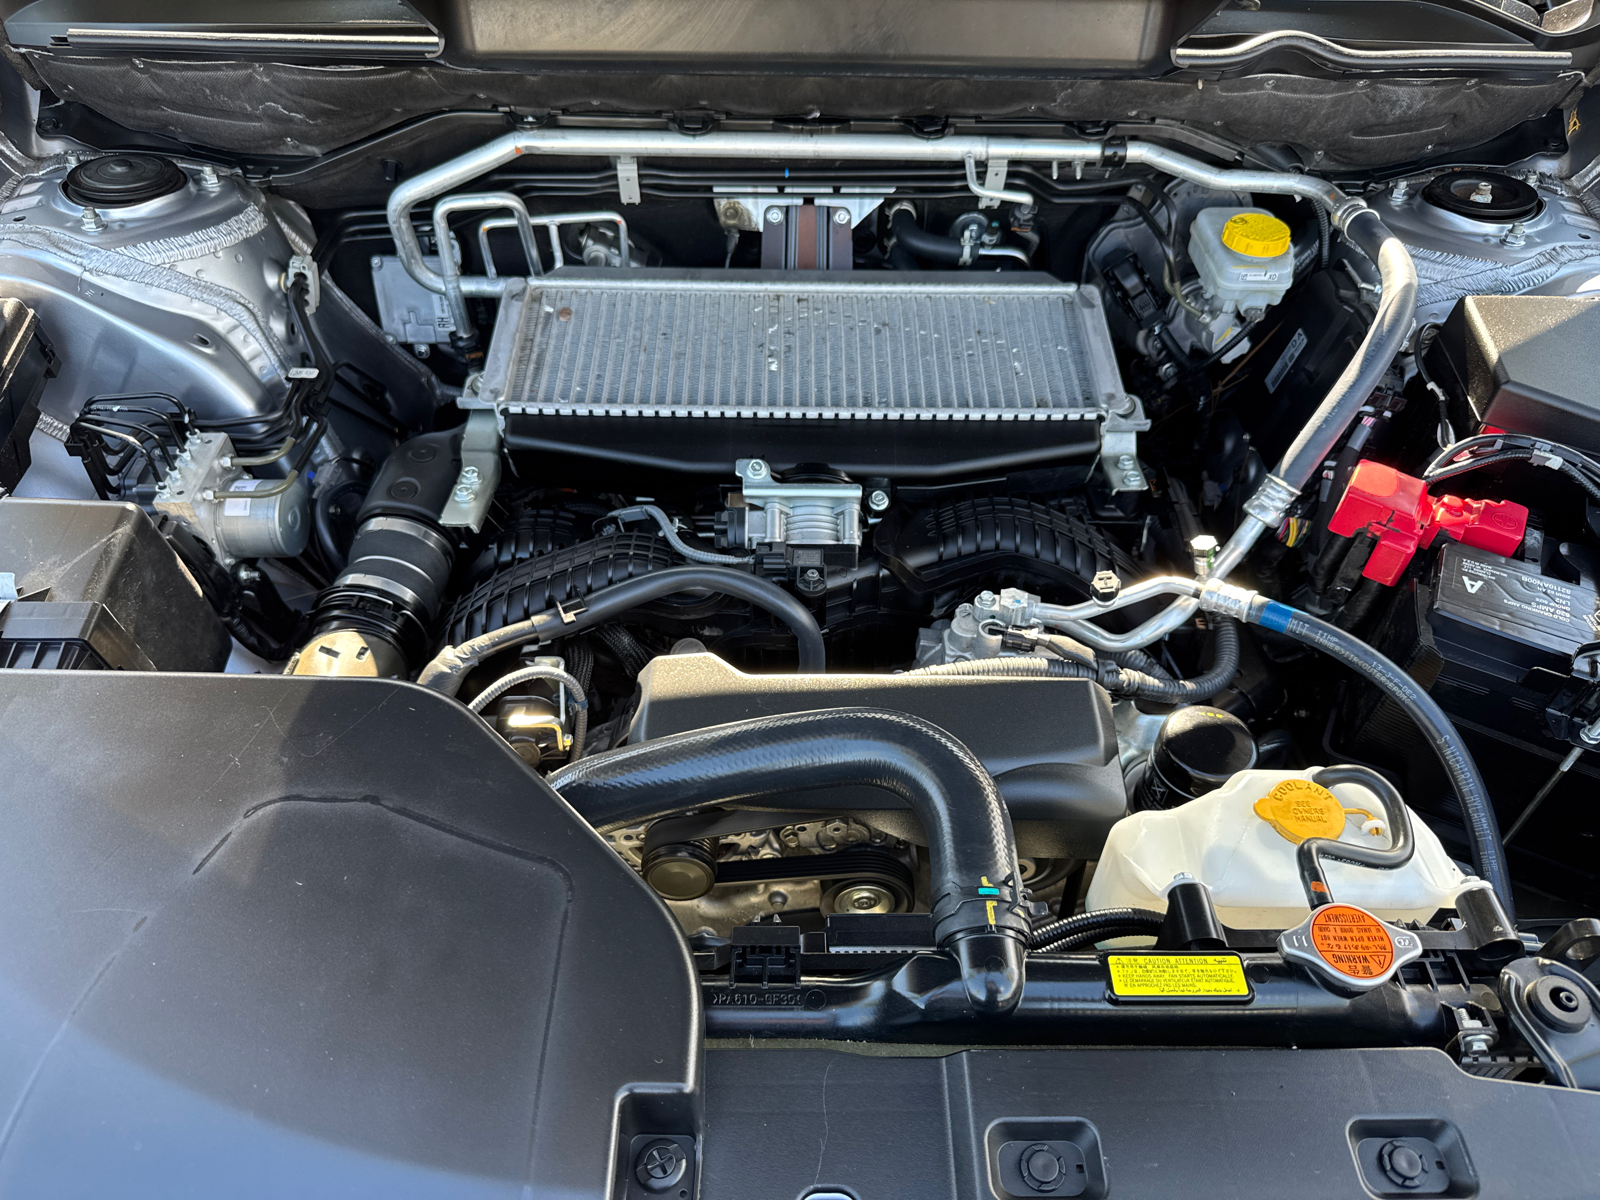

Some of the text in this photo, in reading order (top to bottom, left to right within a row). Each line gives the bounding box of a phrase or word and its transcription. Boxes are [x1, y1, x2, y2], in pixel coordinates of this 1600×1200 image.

[1462, 576, 1484, 594] A
[1531, 602, 1554, 612] AMPS
[1549, 602, 1570, 611] GROUP
[1555, 598, 1570, 606] LN2
[1504, 599, 1570, 622] COLD CRANKING AMPS
[1317, 630, 1339, 642] 11HP
[1272, 782, 1333, 802] COOLANT
[1443, 745, 1476, 792] NICHIRIN
[1488, 850, 1498, 872] 11HP
[1332, 954, 1370, 964] WARNING
[1348, 965, 1373, 976] 警告
